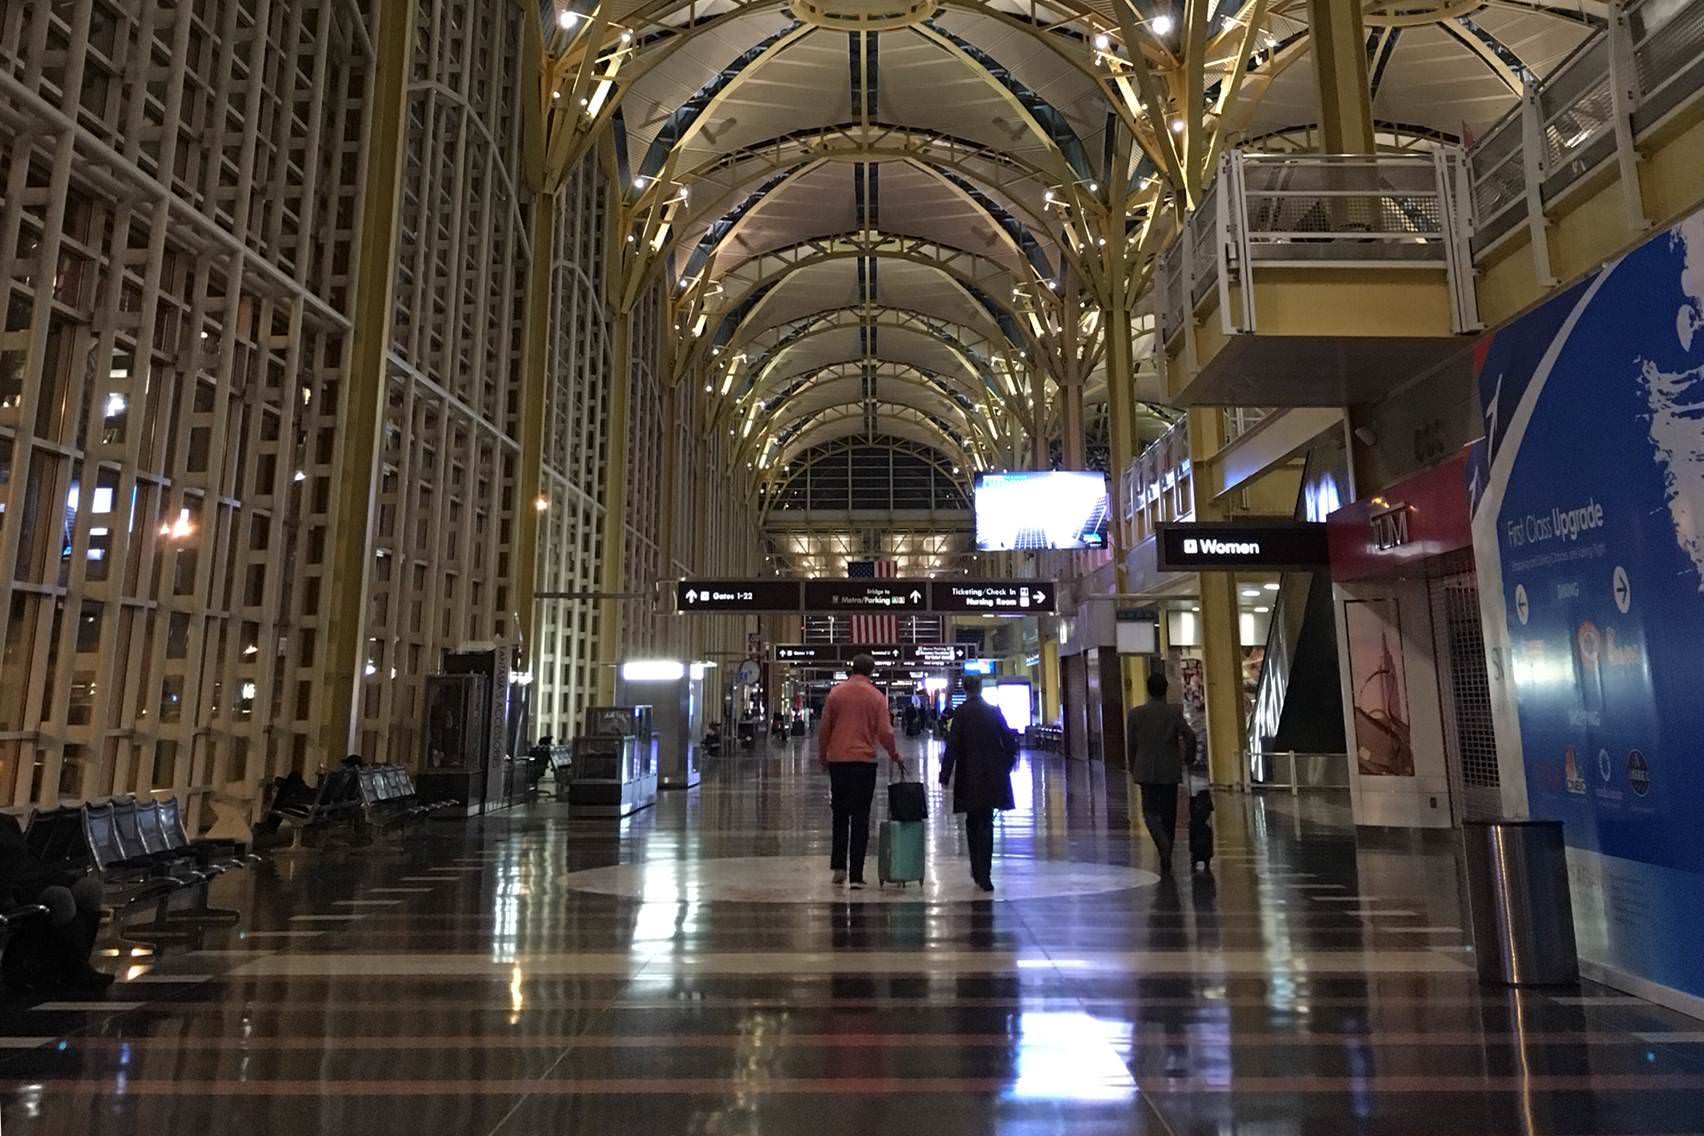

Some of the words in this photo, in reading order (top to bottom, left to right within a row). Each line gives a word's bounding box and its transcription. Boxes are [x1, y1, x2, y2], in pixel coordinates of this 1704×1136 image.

[1507, 517, 1525, 548] First
[1525, 513, 1553, 544] Class
[1552, 497, 1604, 542] Upgrade
[1200, 539, 1260, 554] Women
[712, 592, 735, 600] Gates
[737, 592, 753, 600] 1-22
[952, 587, 1007, 597] Ticketing/Check
[1009, 588, 1016, 596] In
